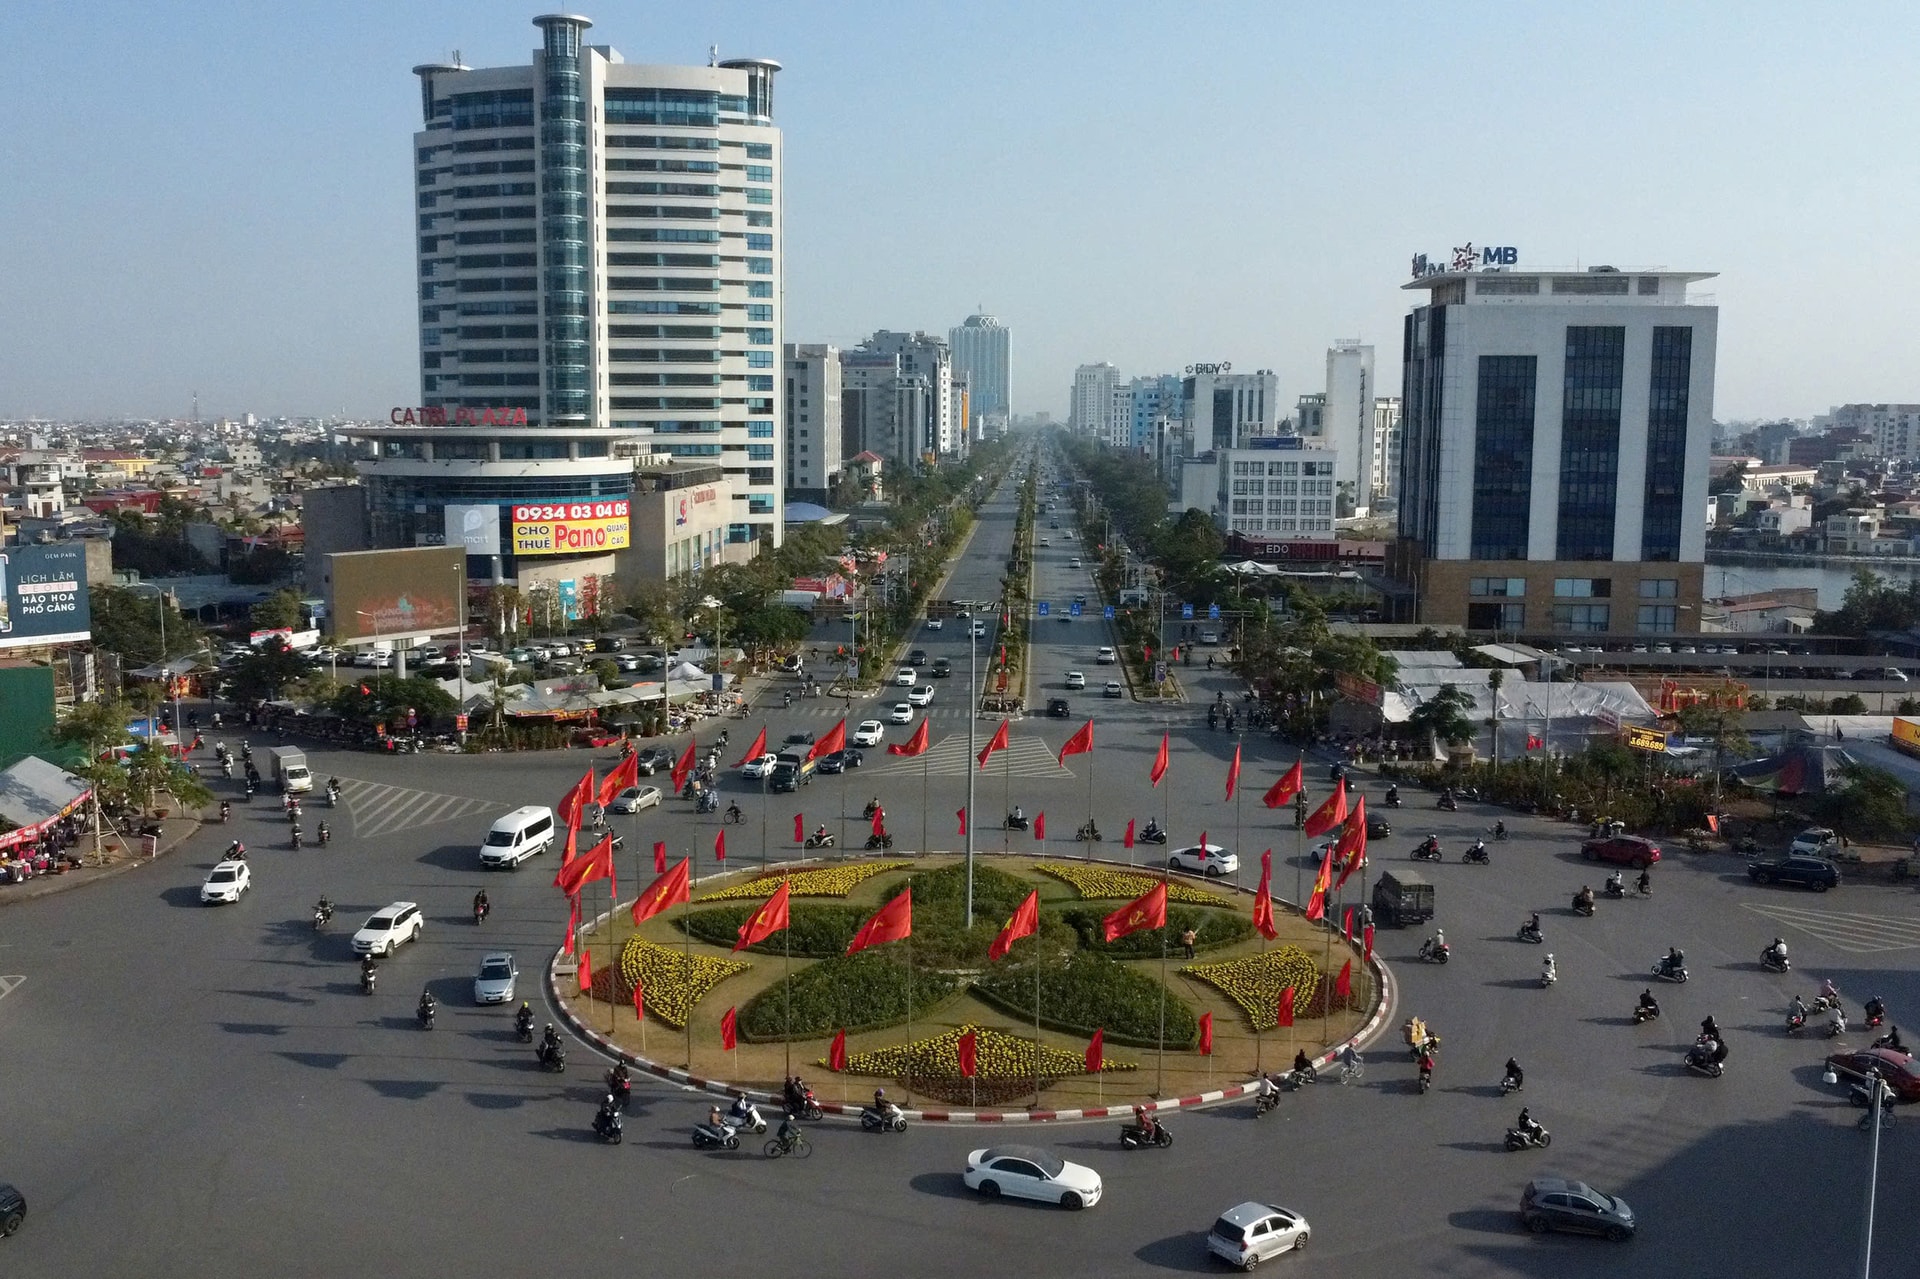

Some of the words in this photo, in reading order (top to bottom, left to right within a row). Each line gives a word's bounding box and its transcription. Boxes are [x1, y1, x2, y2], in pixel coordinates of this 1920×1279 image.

[1482, 246, 1518, 265] MB
[1195, 363, 1222, 375] BIDV
[455, 406, 528, 426] PLAZA
[516, 506, 566, 520] 0934
[570, 504, 592, 519] 03
[595, 503, 613, 518] 04
[614, 502, 628, 516] 05
[516, 525, 550, 536] CHO
[554, 524, 606, 549] Pano
[517, 536, 551, 549] THUÊ
[1265, 544, 1289, 554] EDO
[22, 584, 75, 593] SEOUL
[22, 594, 46, 604] HÀO
[51, 593, 75, 602] HOA
